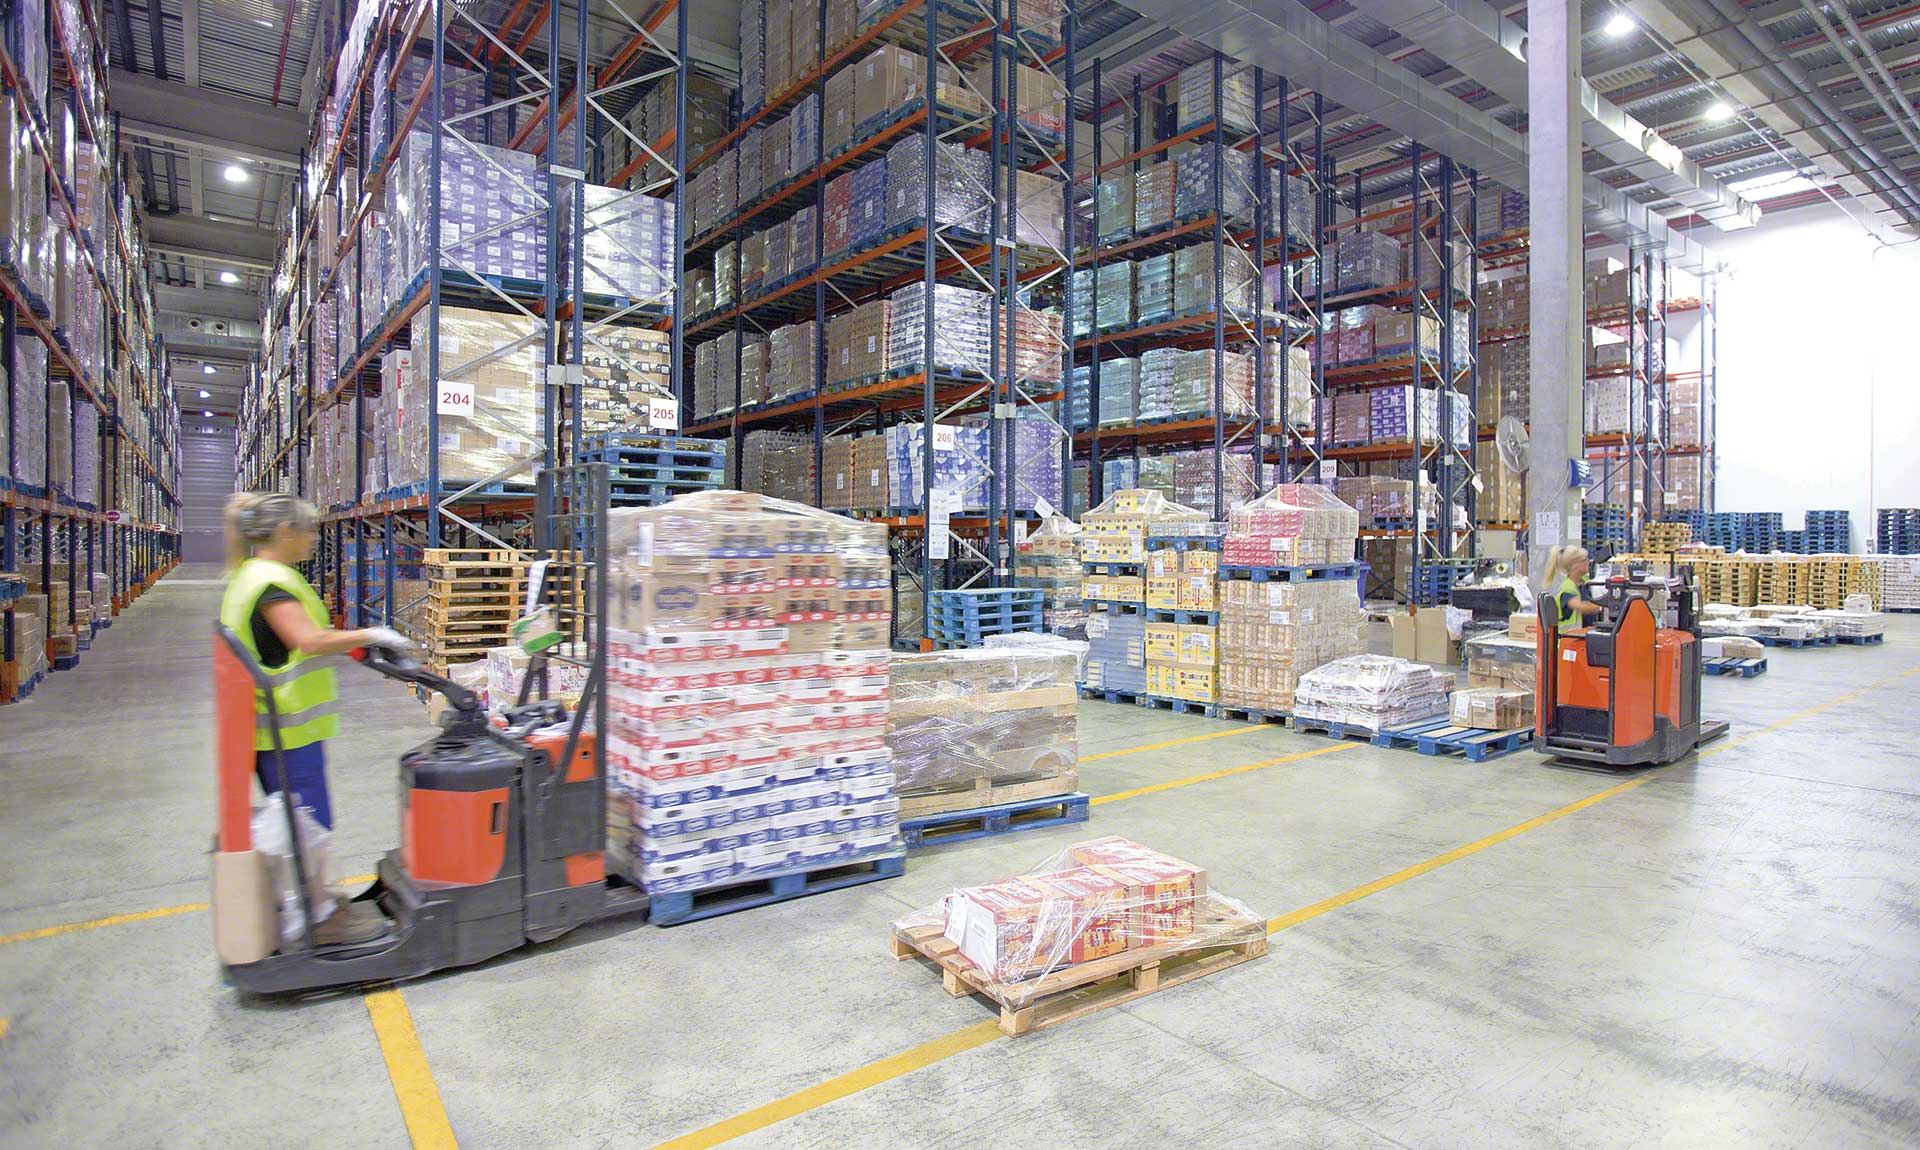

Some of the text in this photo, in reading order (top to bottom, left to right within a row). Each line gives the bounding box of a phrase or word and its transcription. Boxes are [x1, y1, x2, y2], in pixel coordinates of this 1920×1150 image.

[443, 392, 470, 405] 204
[653, 407, 675, 420] 205
[936, 432, 953, 443] 206
[1321, 465, 1335, 473] 209
